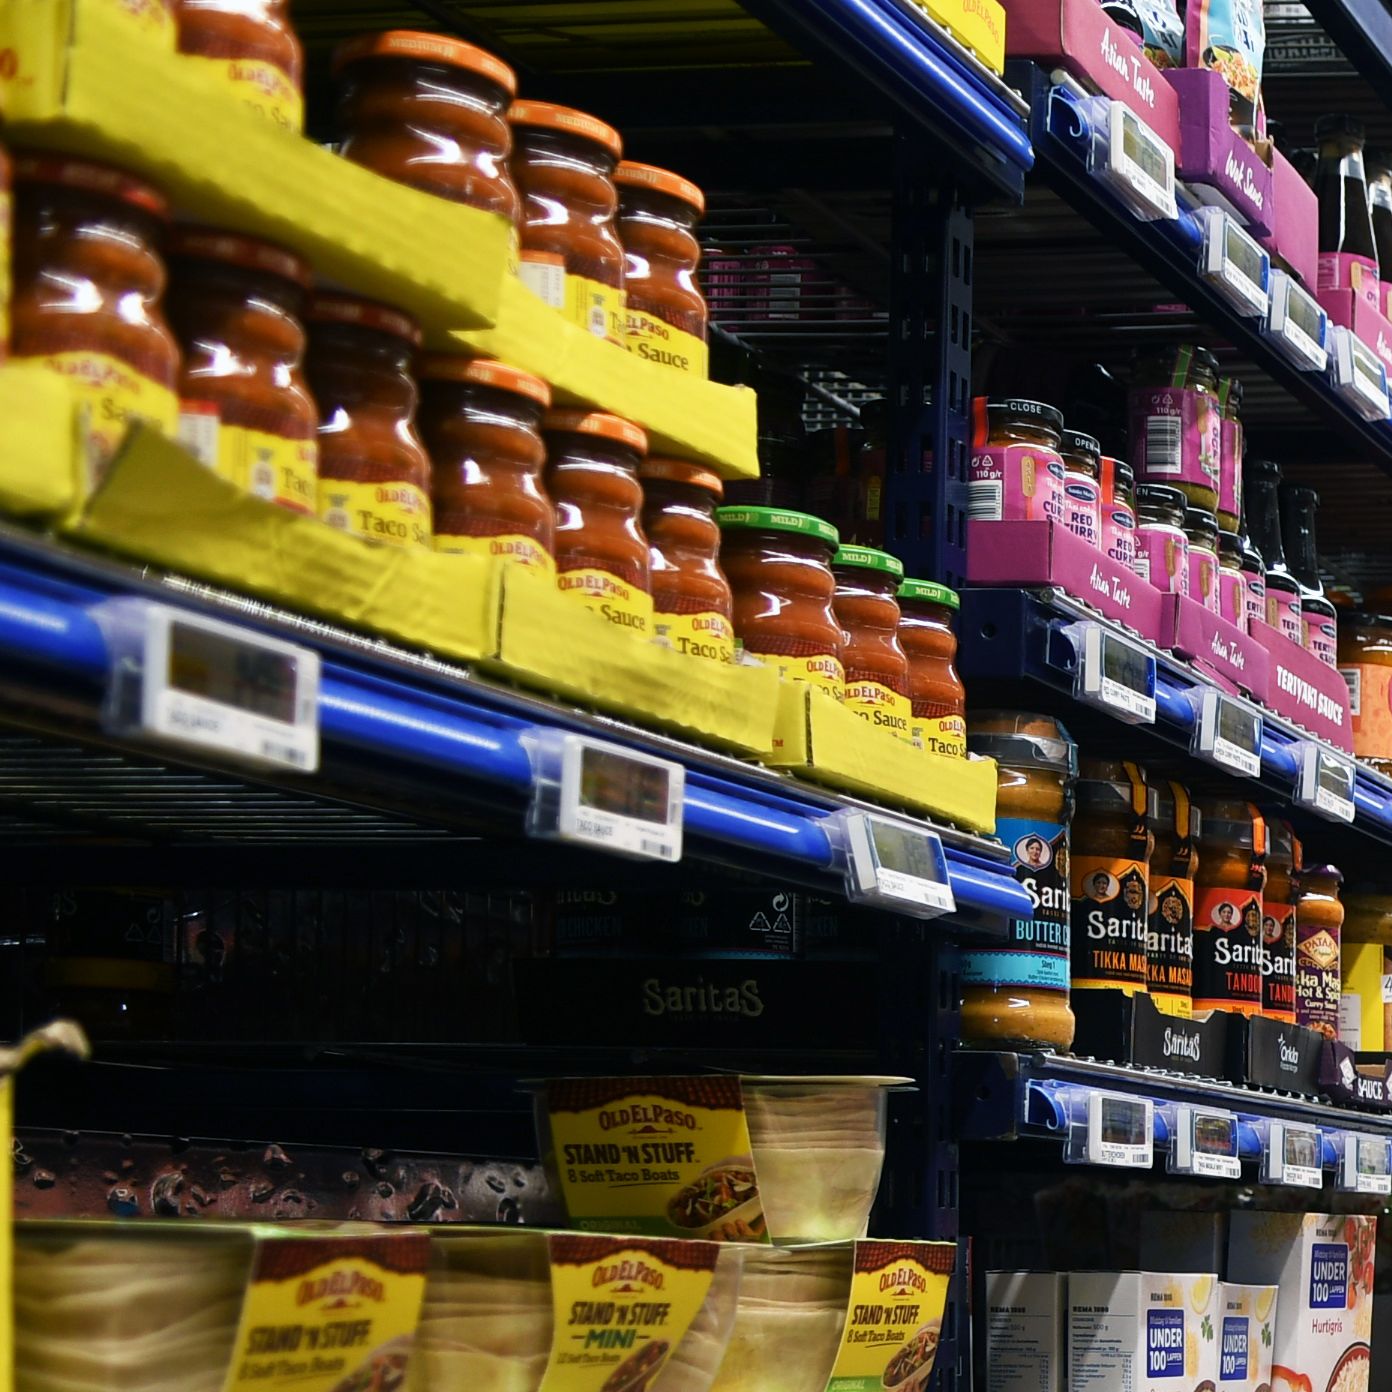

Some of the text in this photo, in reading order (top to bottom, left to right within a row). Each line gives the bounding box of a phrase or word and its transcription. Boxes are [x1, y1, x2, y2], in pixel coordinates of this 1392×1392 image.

[1101, 27, 1157, 110] Asian Taste
[1225, 150, 1245, 190] Wok
[638, 342, 690, 371] Sauce
[1010, 401, 1042, 415] CLOSE
[1074, 437, 1095, 452] OPEN
[976, 468, 988, 479] 110
[361, 511, 409, 539] Taco
[771, 512, 800, 526] MILD
[1071, 510, 1093, 527] RED
[1115, 536, 1133, 552] RED
[842, 553, 869, 564] MILD
[915, 586, 939, 599] MILD
[1091, 562, 1131, 610] Asian Taste
[602, 605, 646, 631] Sauce
[678, 637, 718, 663] Taco
[1211, 631, 1245, 671] Asian Taste
[1276, 664, 1344, 728] TERIYAKI SAUCE
[873, 711, 907, 731] Sauce
[928, 737, 958, 757] Taco
[1015, 918, 1062, 945] BUTTER
[1087, 909, 1148, 941] Sarit
[1093, 950, 1127, 970] TIKKA
[1213, 937, 1263, 964] Sarit
[1357, 1077, 1384, 1101] SAUCE
[563, 1142, 622, 1167] STAND
[640, 1142, 696, 1166] STUFF
[567, 1167, 680, 1184] 8 Soft Taco Boats
[1313, 1262, 1346, 1284] UNDER
[1312, 1282, 1329, 1304] 100
[568, 1302, 615, 1327] STAND
[630, 1302, 669, 1326] STUFF
[851, 1304, 884, 1326] STAND
[894, 1304, 919, 1325] STUFF
[1072, 1306, 1092, 1314] REMA
[847, 1328, 905, 1343] 8 Soft Taco Boats
[1312, 1317, 1343, 1336] Hurtigris
[584, 1329, 636, 1350] MINI
[1149, 1327, 1183, 1349] UNDER
[1223, 1333, 1248, 1354] UNDER
[1149, 1350, 1167, 1371] 100
[1222, 1355, 1236, 1375] 100
